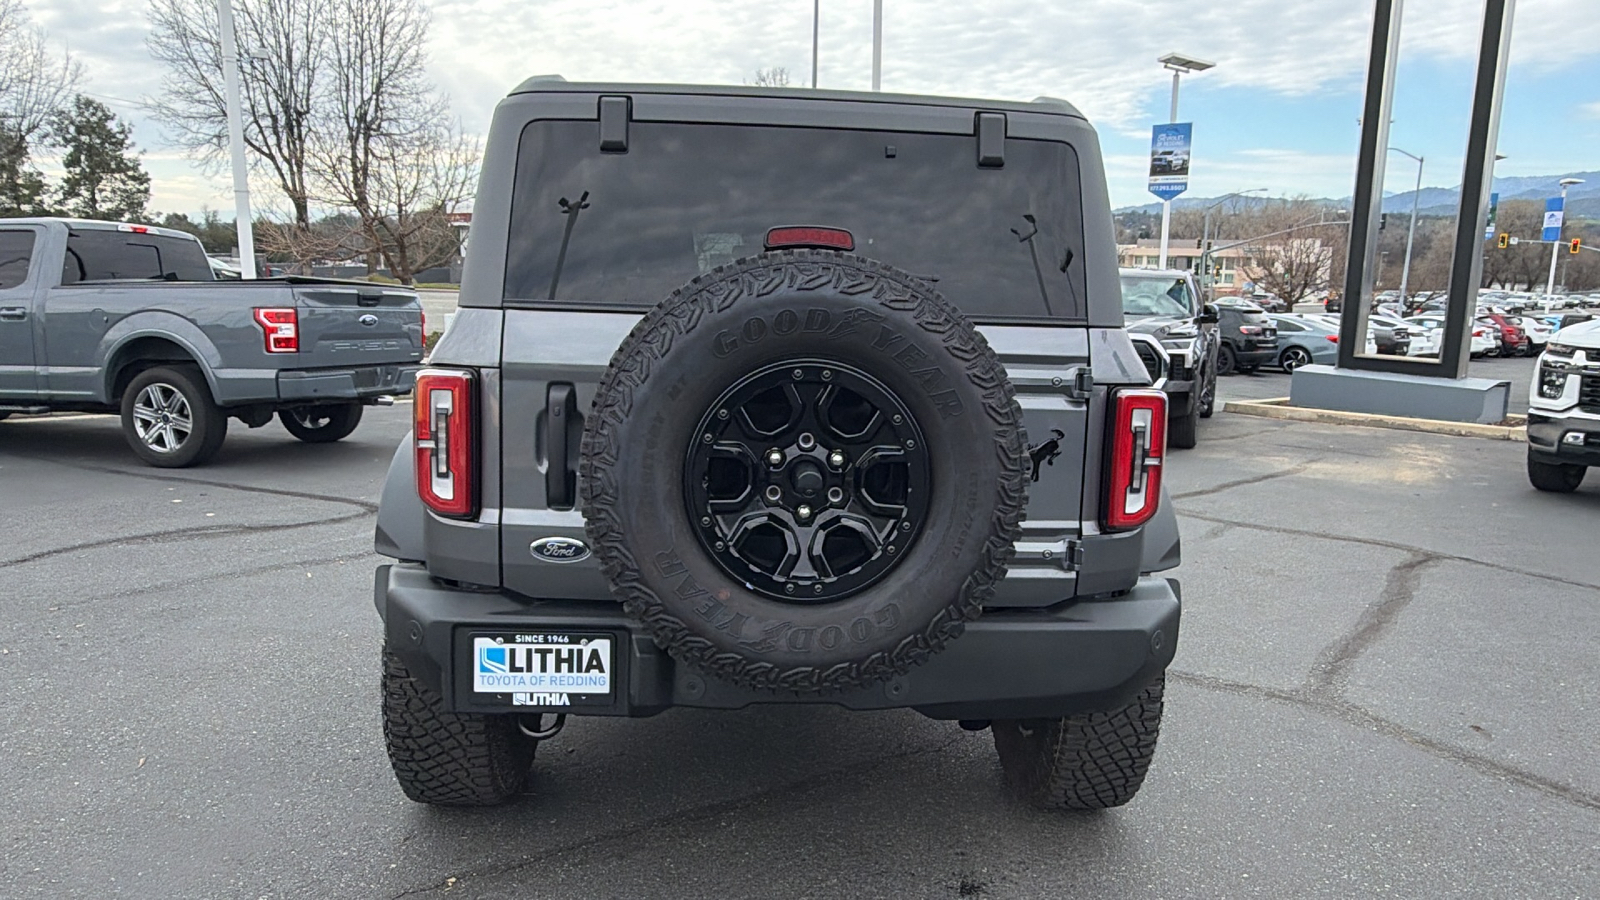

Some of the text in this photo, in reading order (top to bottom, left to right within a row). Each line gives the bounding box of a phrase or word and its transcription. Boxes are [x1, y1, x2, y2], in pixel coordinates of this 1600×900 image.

[543, 542, 576, 557] Ford
[515, 635, 570, 644] SINCE 1946
[509, 648, 606, 673] LITHIA
[480, 675, 607, 686] TOYOTA OF REDDING
[525, 693, 570, 706] LITHIA
